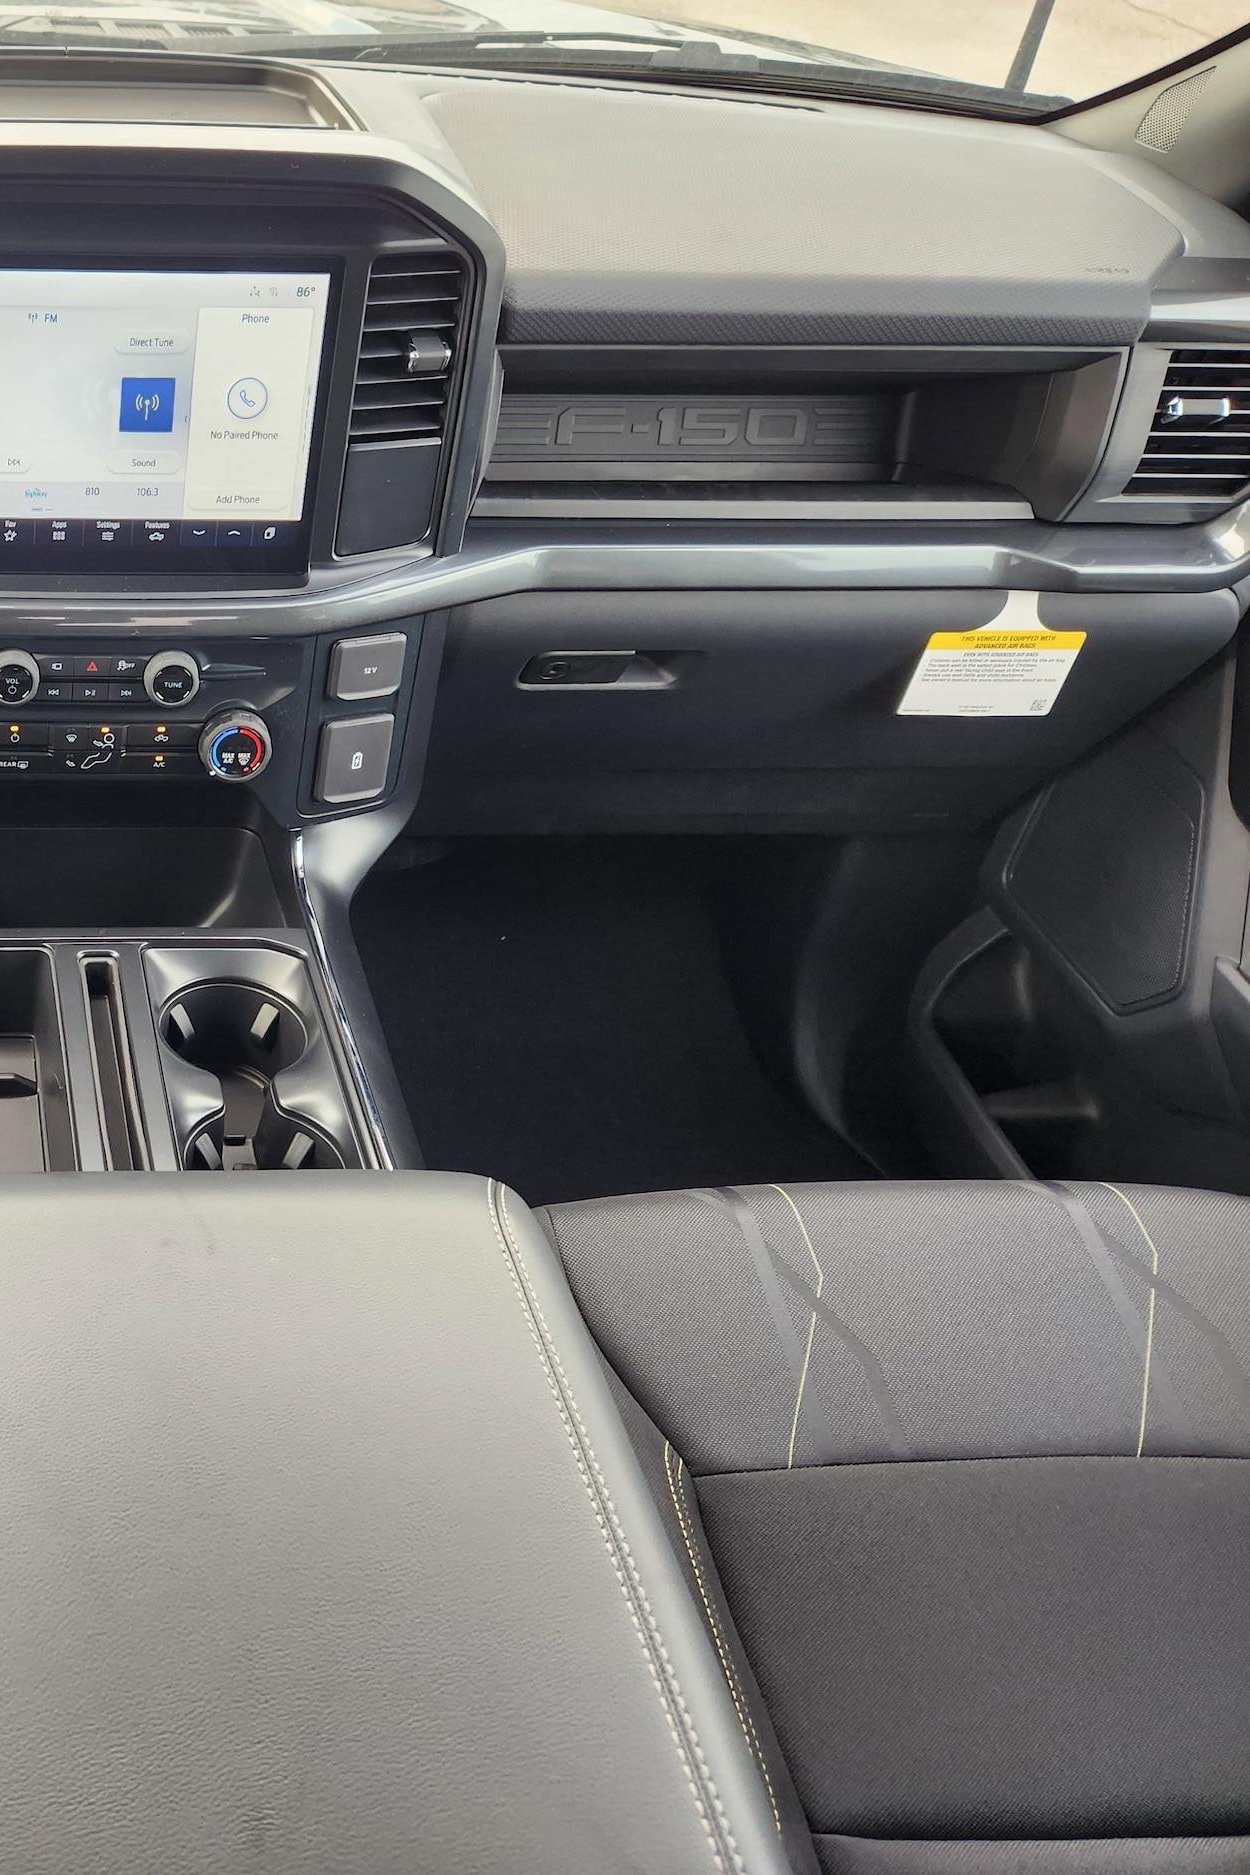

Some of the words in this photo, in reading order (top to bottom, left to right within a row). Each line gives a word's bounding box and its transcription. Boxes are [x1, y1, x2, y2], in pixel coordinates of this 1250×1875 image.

[296, 286, 316, 297] 86°
[44, 313, 58, 323] FM
[241, 313, 270, 323] Phone
[129, 337, 152, 347] Direct
[154, 338, 174, 347] Tune
[554, 406, 808, 446] F-150
[210, 430, 223, 440] No
[224, 430, 251, 440] Paired
[251, 430, 278, 440] Phone
[131, 459, 156, 468] Sound
[85, 487, 100, 496] 810
[137, 487, 159, 497] 106.3
[215, 495, 233, 504] Add
[233, 495, 260, 505] Phone
[5, 520, 16, 528] Fav
[52, 520, 67, 529] Apps
[96, 521, 120, 530] Settings
[145, 521, 170, 529] Features
[164, 681, 183, 689] TUNE
